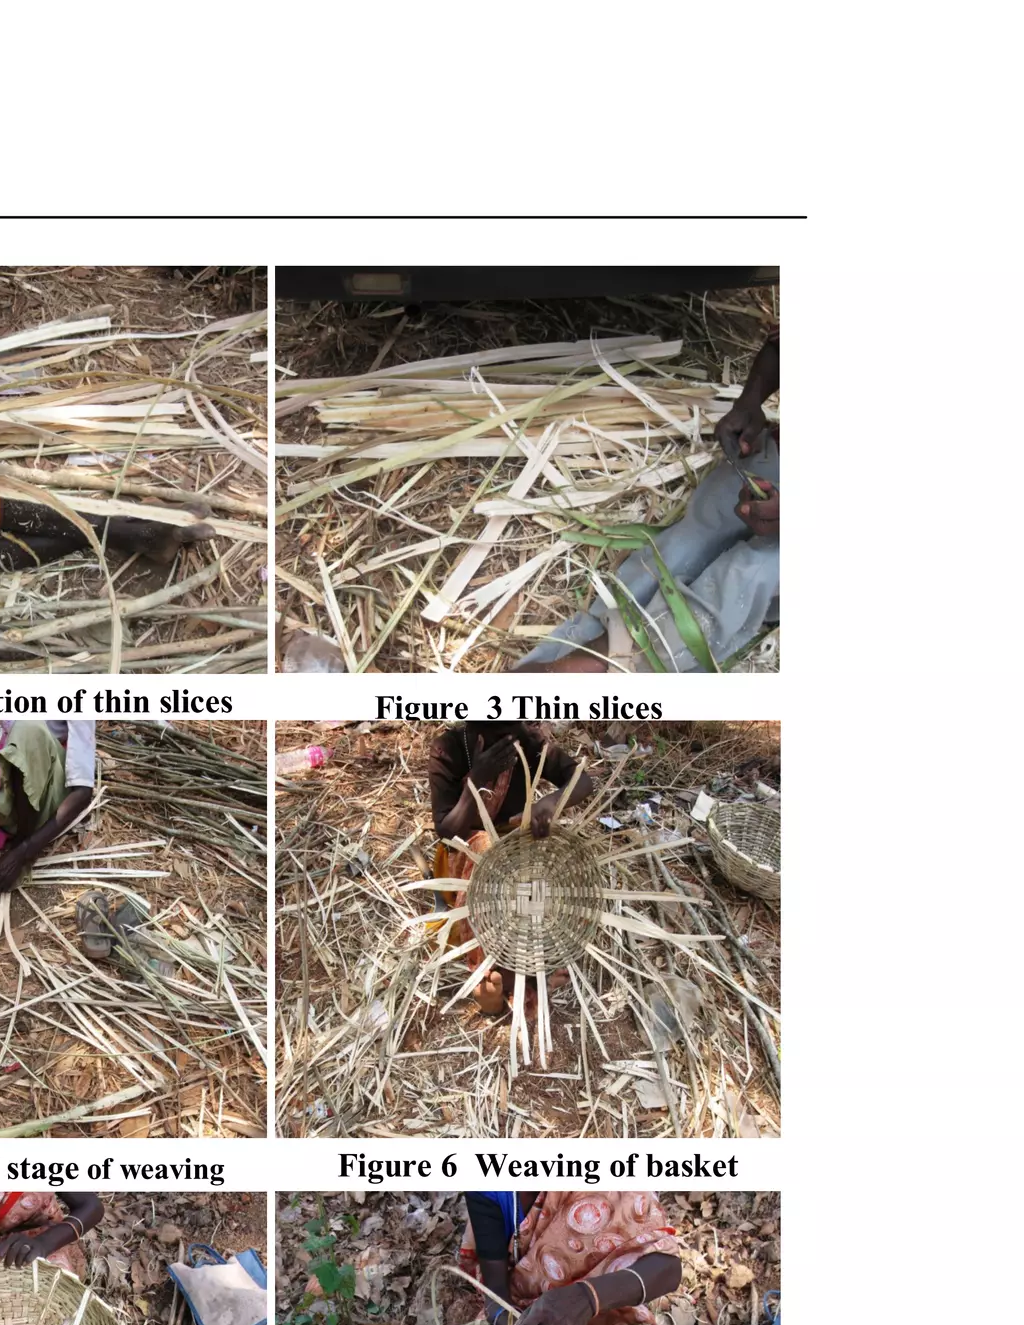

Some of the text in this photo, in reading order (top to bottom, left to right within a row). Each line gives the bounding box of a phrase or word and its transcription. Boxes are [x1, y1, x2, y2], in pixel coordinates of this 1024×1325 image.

[57, 688, 87, 714] of
[93, 688, 150, 714] thin
[159, 688, 233, 714] slices
[374, 695, 663, 721] Figure 3 Thin slices
[7, 1157, 80, 1187] stage
[87, 1157, 115, 1180] of
[119, 1157, 225, 1187] weaving
[337, 1152, 739, 1185] Figure 6 Weaving of basket
